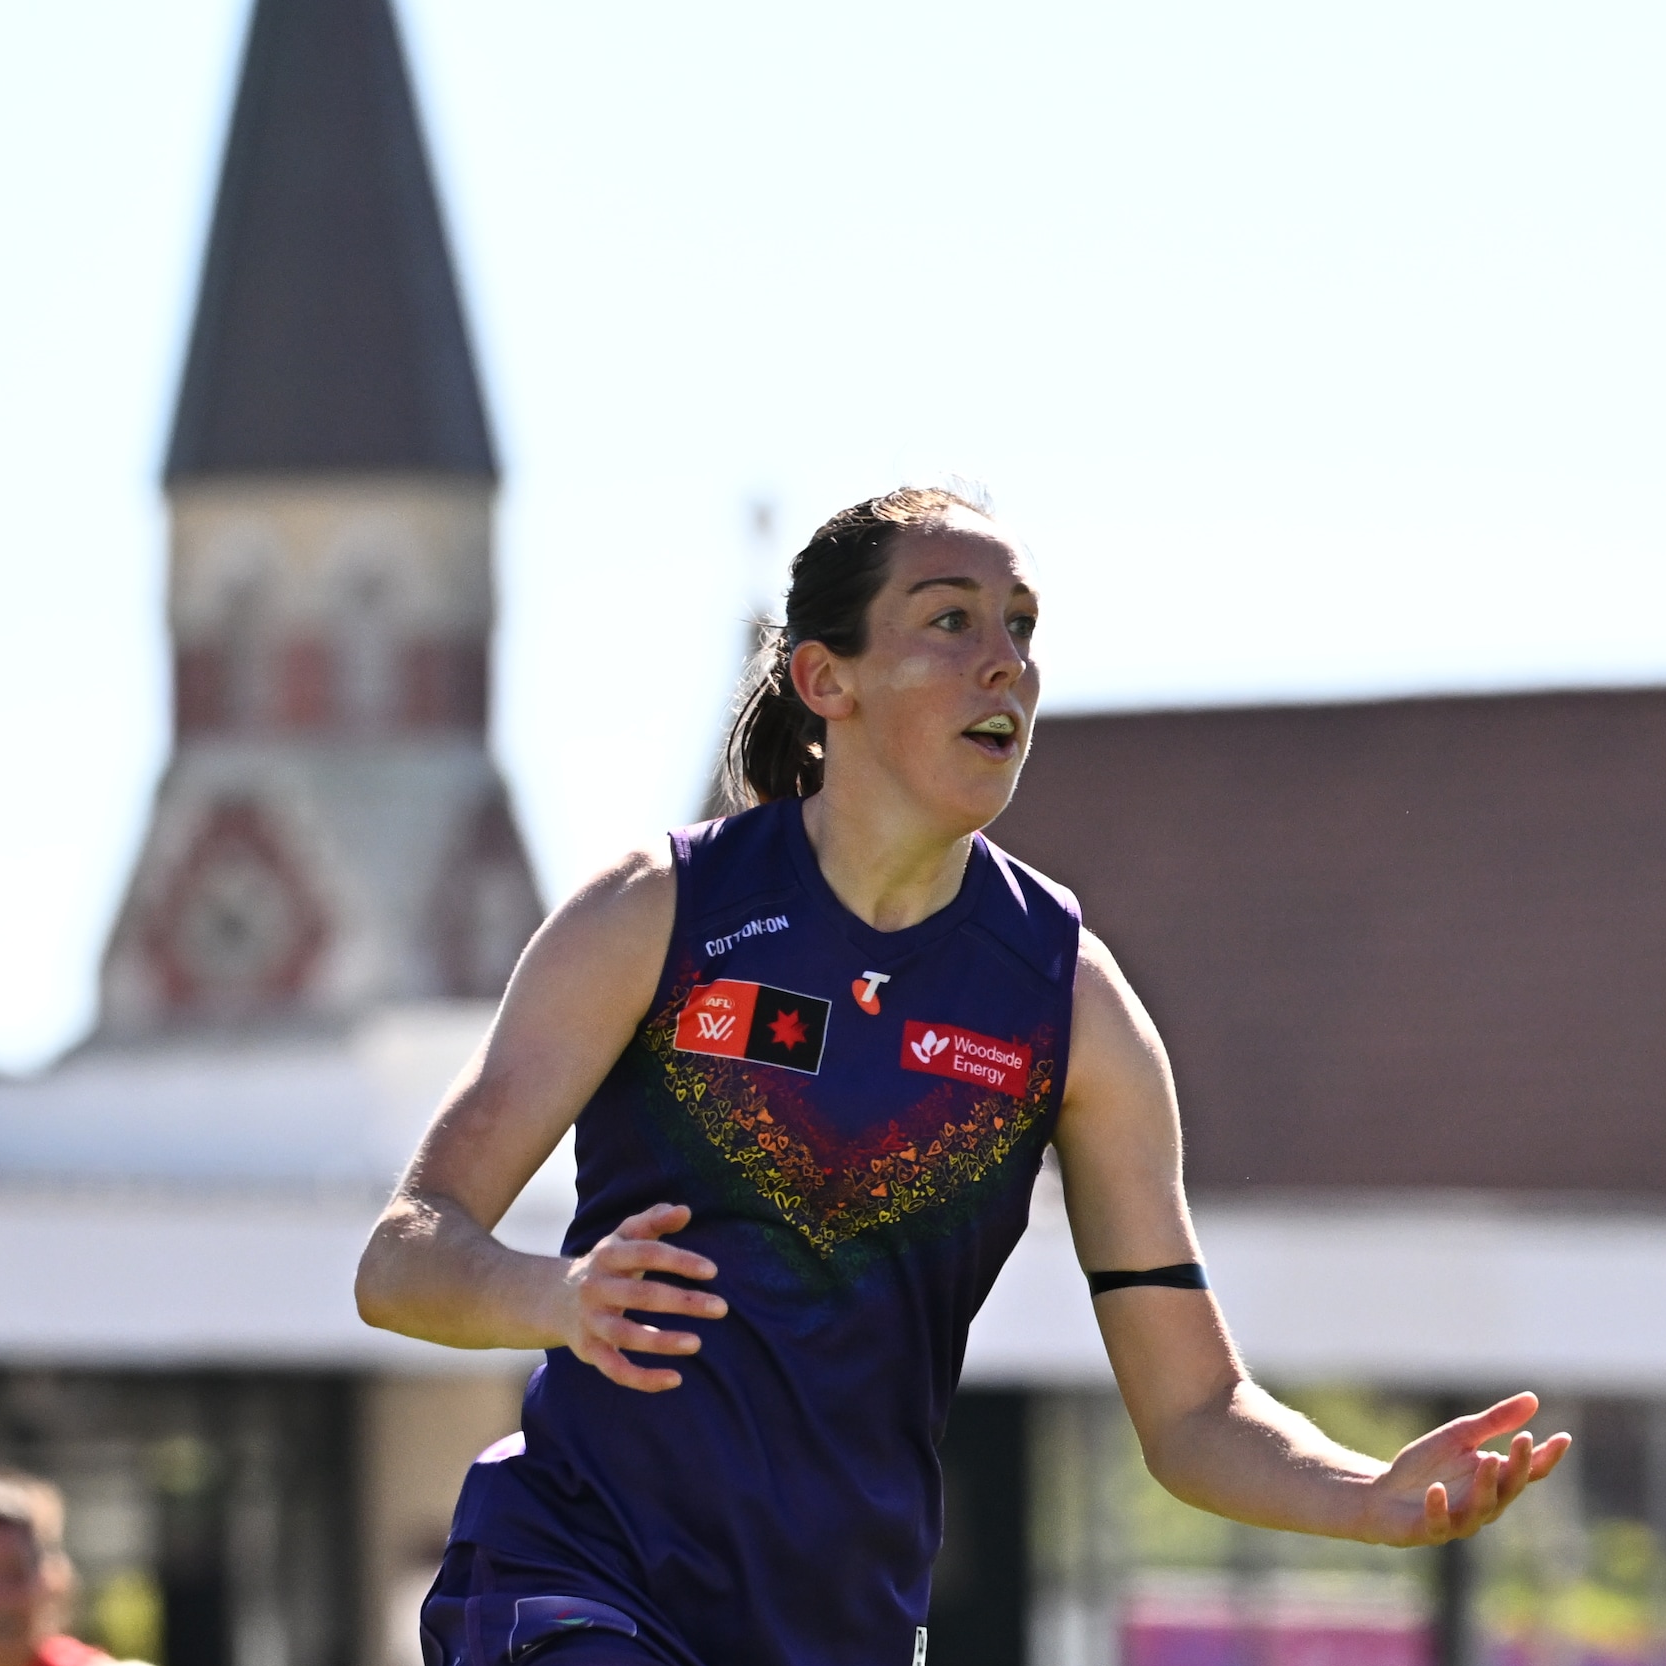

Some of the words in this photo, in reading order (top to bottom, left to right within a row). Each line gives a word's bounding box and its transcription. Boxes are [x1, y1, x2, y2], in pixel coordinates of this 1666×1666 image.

[705, 997, 732, 1010] AFL
[954, 1035, 1023, 1070] Woodside
[953, 1054, 1006, 1087] Energy
